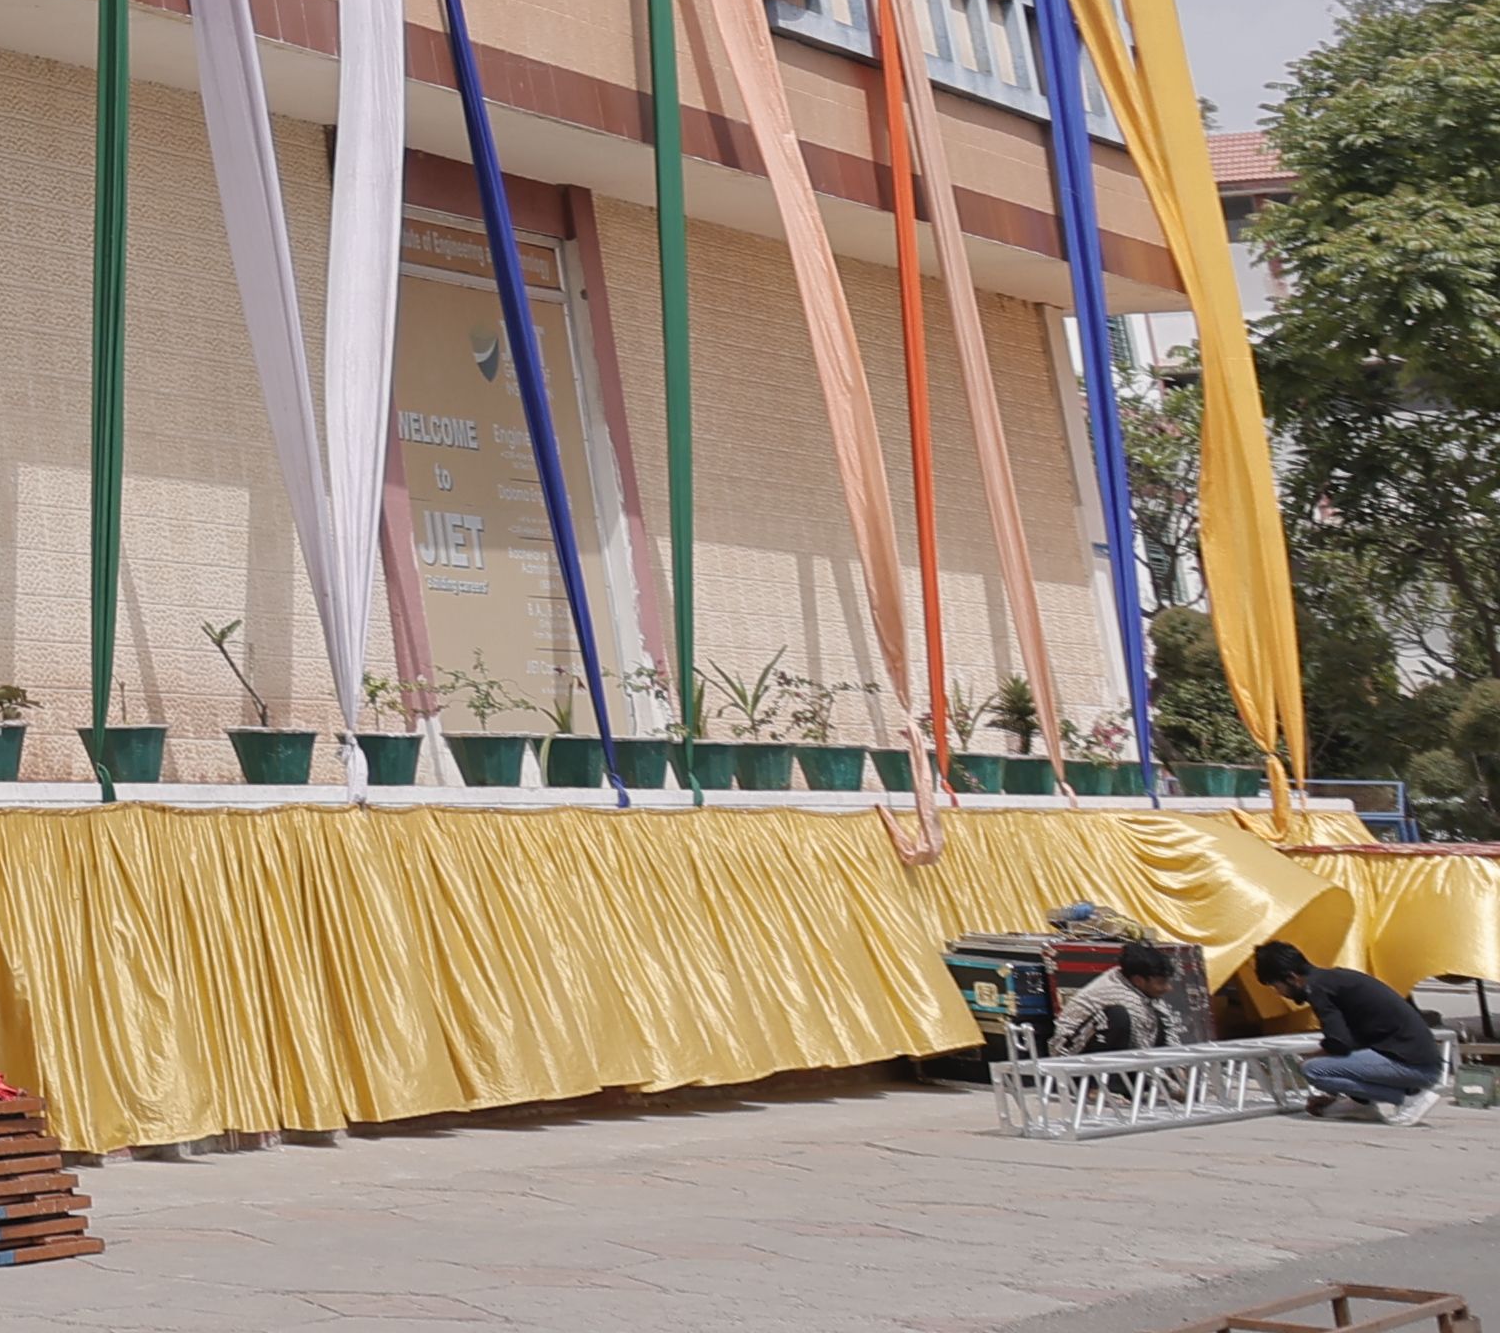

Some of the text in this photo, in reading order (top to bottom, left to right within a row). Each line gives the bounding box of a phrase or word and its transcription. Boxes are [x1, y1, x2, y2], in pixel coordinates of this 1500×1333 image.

[398, 410, 480, 451] WELCOME
[434, 462, 453, 491] to
[419, 510, 485, 571] JIET
